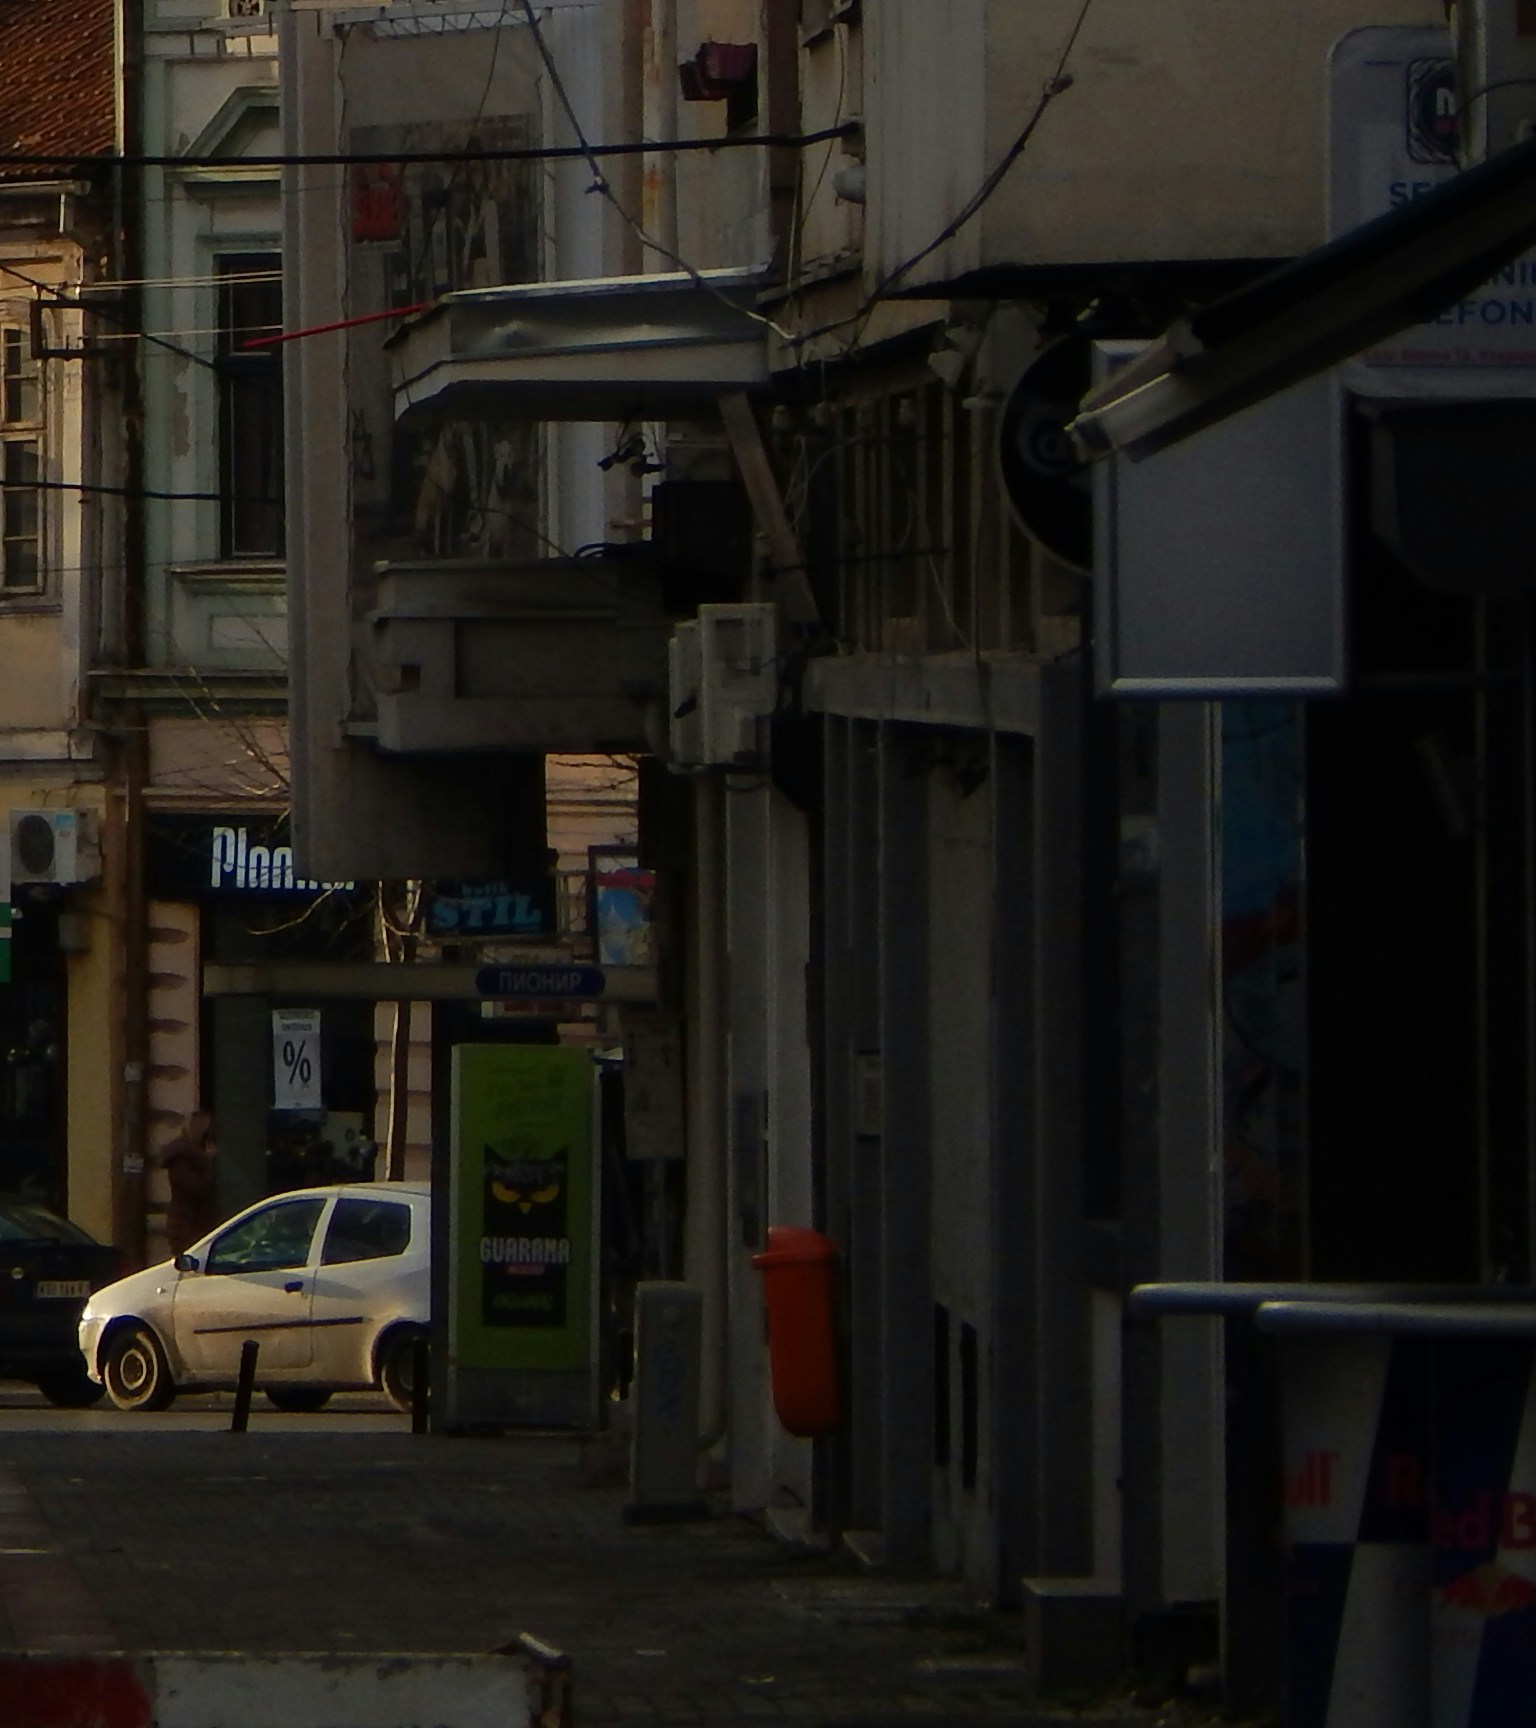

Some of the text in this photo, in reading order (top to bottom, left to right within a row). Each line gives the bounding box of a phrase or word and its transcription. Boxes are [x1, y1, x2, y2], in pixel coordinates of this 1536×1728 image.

[432, 894, 543, 929] STIL
[499, 971, 582, 993] ПИОНИР
[480, 1237, 570, 1264] GUARANA
